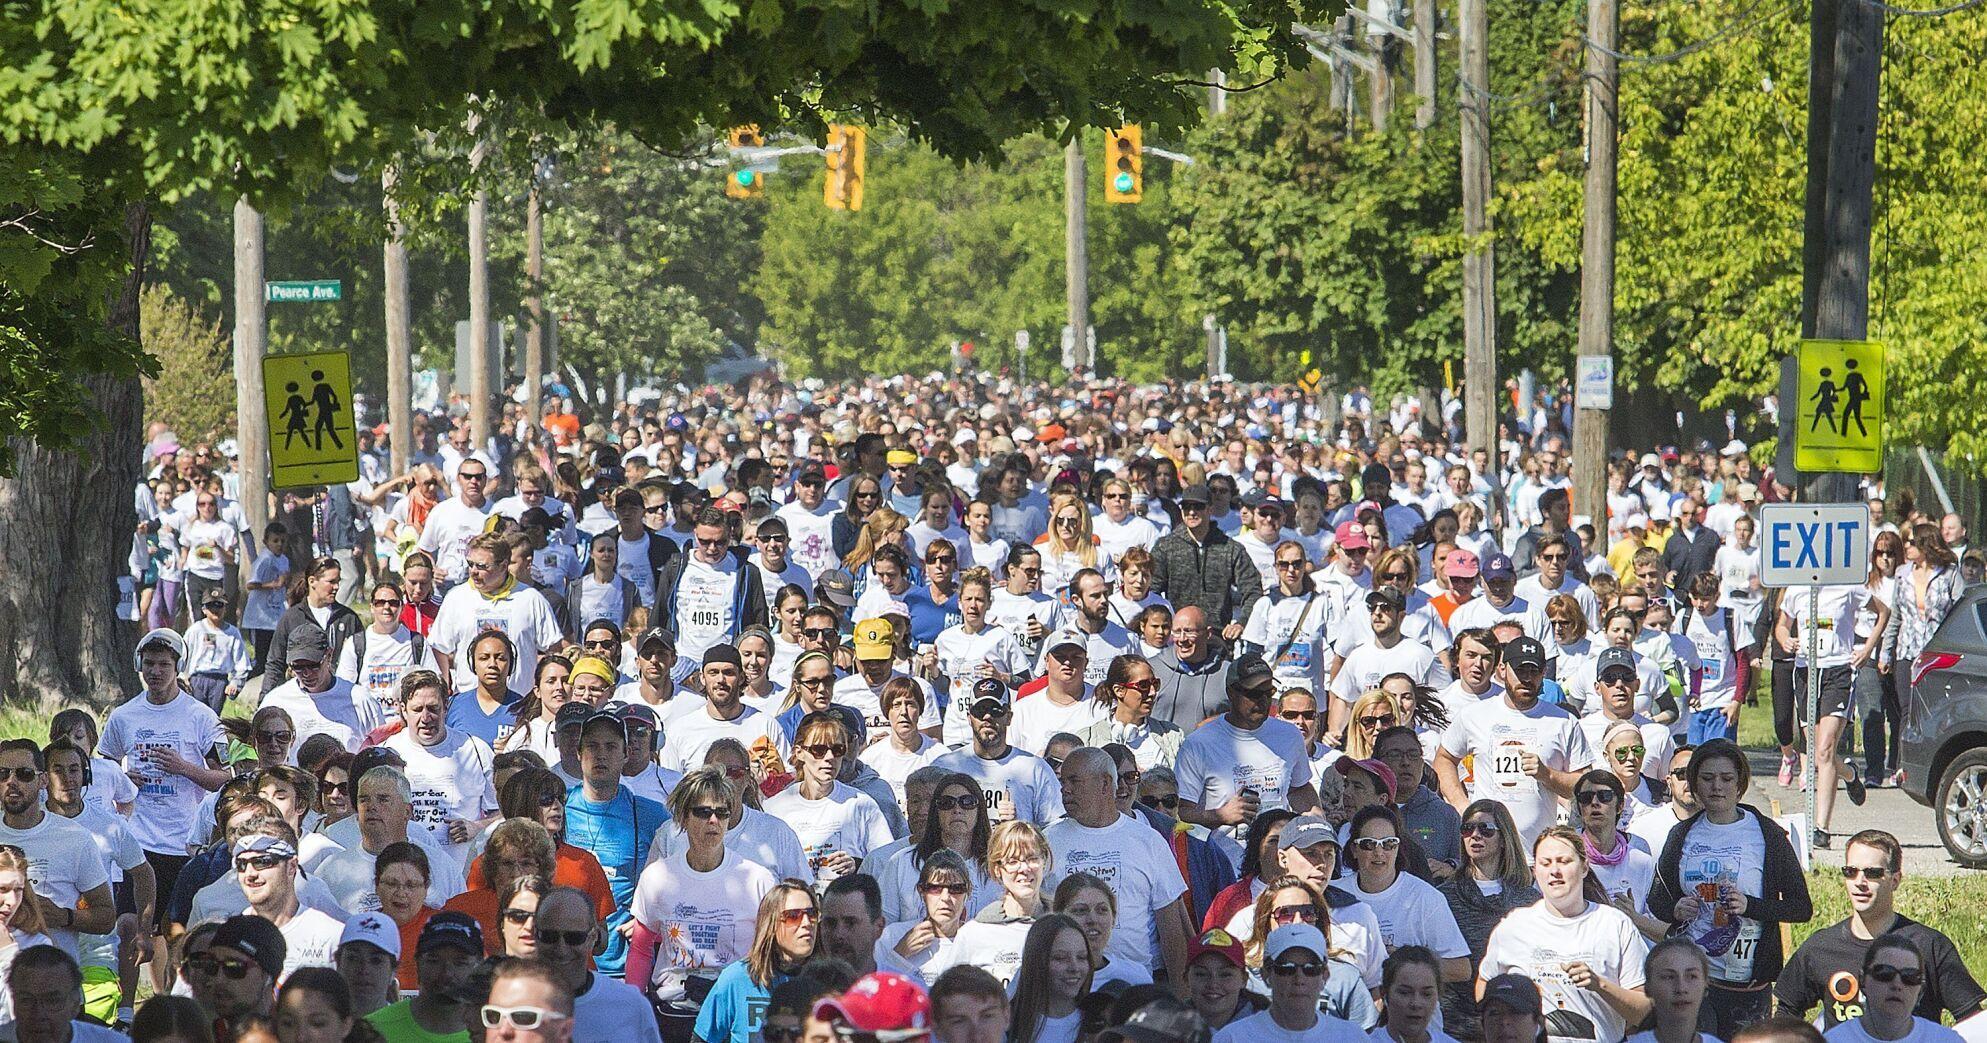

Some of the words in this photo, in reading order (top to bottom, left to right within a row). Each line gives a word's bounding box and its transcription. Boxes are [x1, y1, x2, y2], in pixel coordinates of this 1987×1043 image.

[272, 285, 309, 299] Pearce
[312, 285, 337, 299] Ave.
[1772, 521, 1860, 568] EXIT
[691, 611, 719, 626] 4095
[1495, 756, 1520, 773] 121
[1703, 860, 1718, 874] 10
